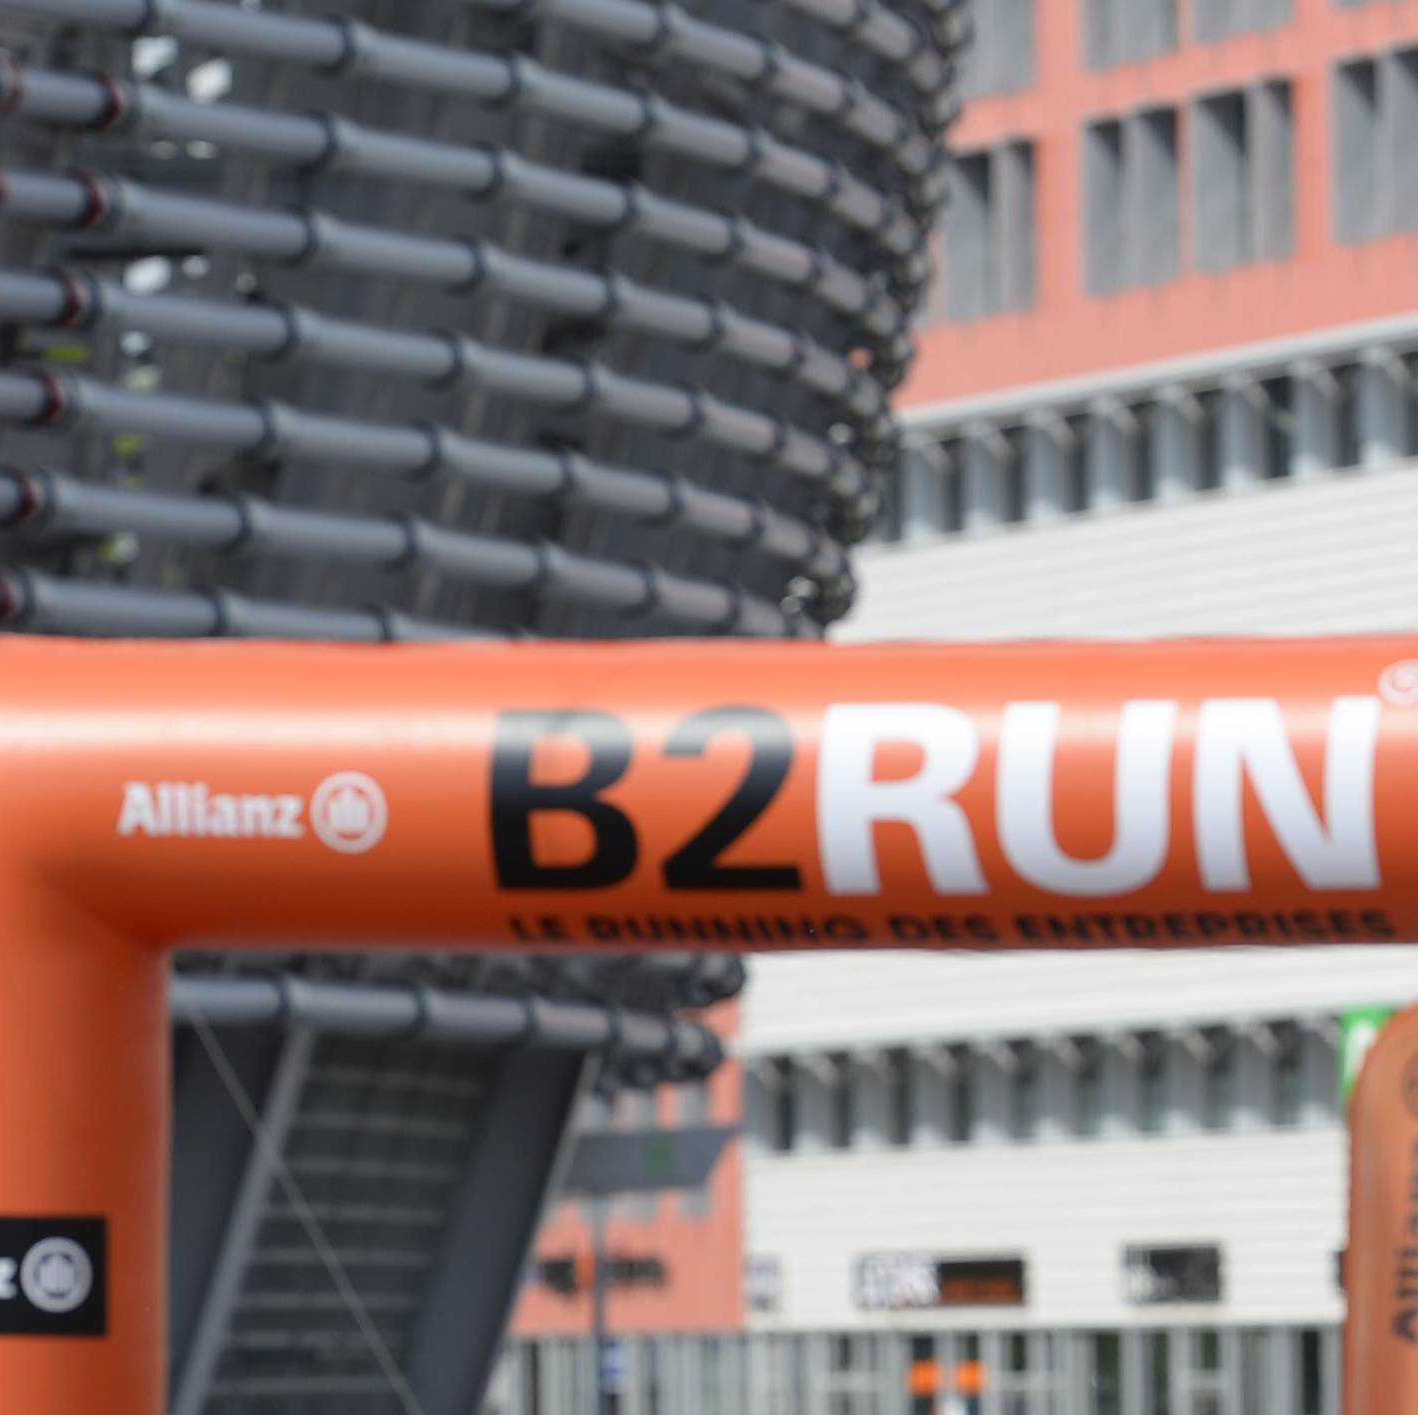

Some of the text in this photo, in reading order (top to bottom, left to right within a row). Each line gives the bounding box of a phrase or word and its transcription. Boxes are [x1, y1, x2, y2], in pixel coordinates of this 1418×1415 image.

[117, 781, 305, 838] Allianz
[488, 694, 1383, 897] B2RUN
[509, 908, 1398, 943] LE RUNNING DES ENTREPRISES
